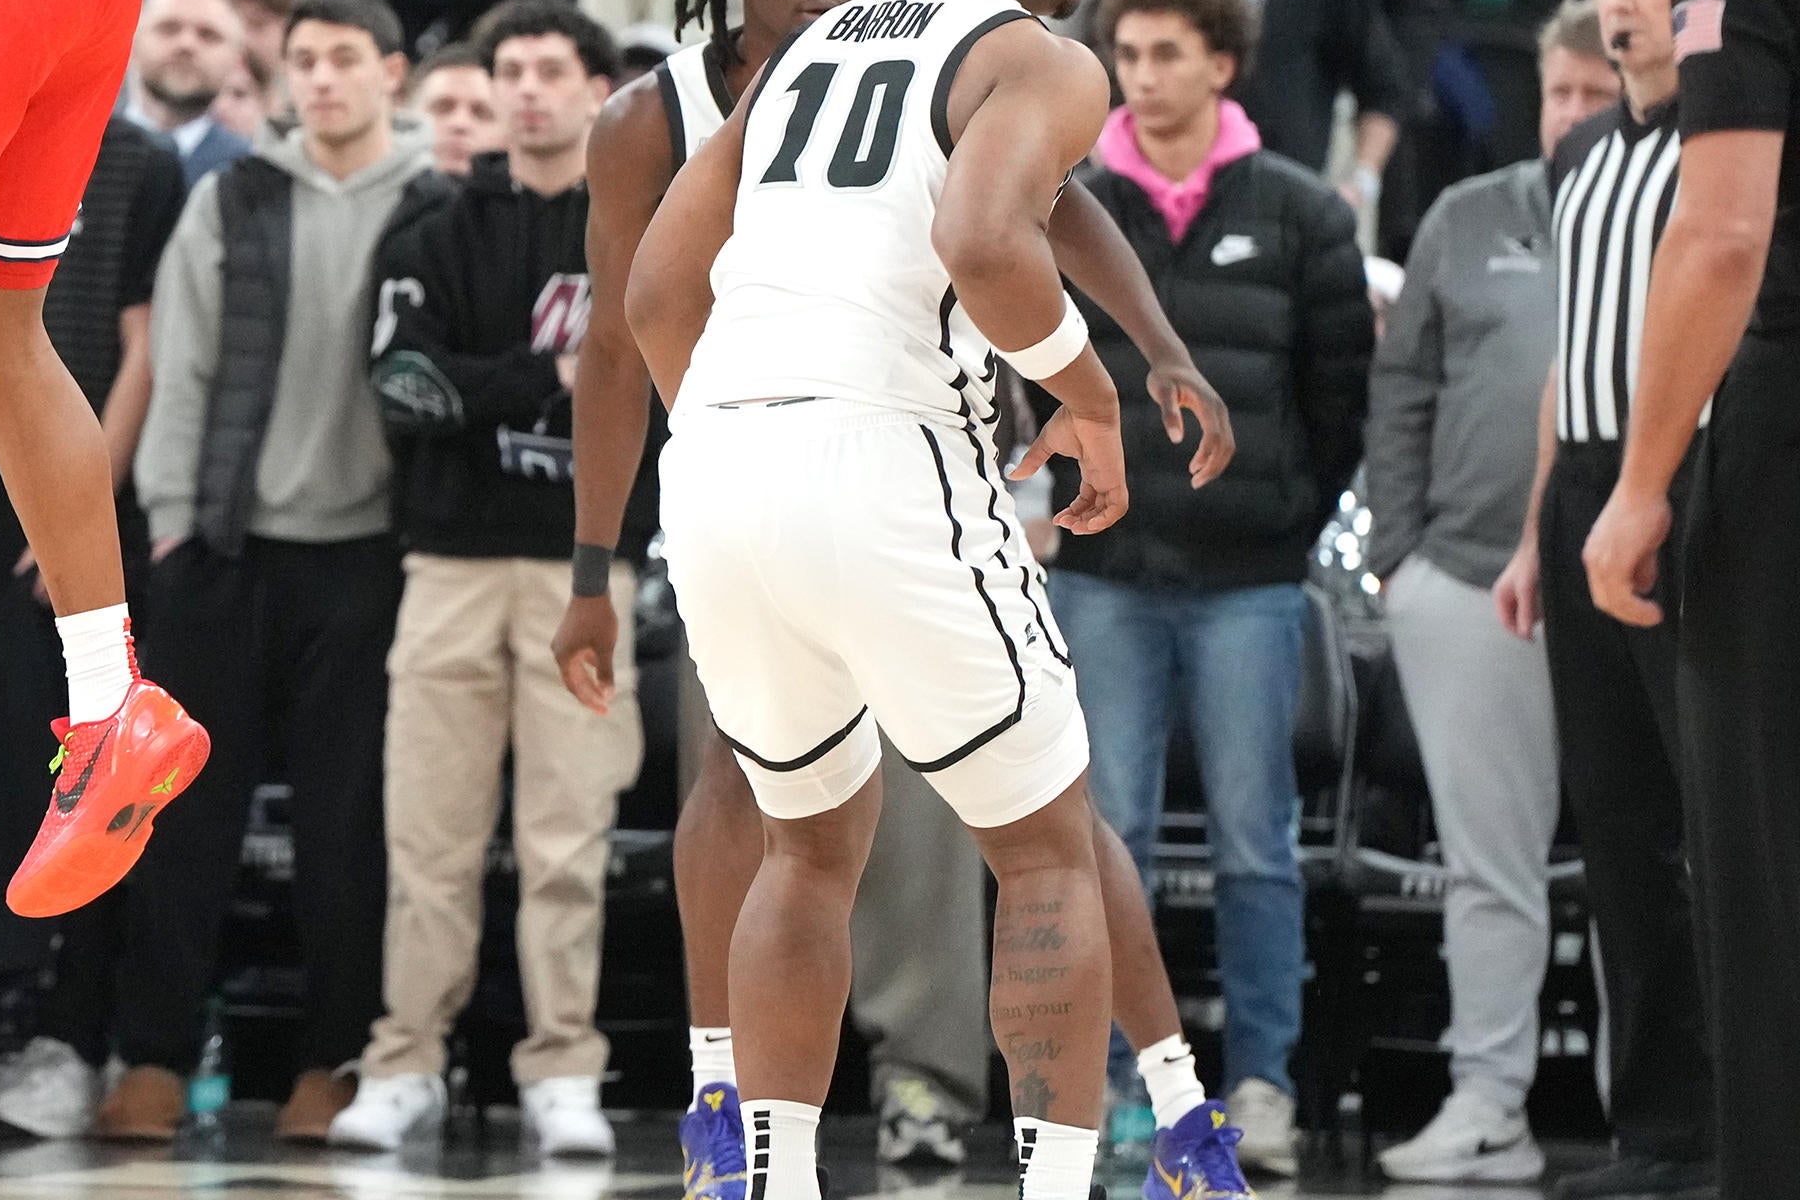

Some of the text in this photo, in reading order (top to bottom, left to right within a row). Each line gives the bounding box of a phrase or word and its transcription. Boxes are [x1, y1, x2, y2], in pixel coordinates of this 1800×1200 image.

[826, 0, 945, 43] BARRON
[756, 58, 918, 192] 10
[1026, 1001, 1073, 1023] your
